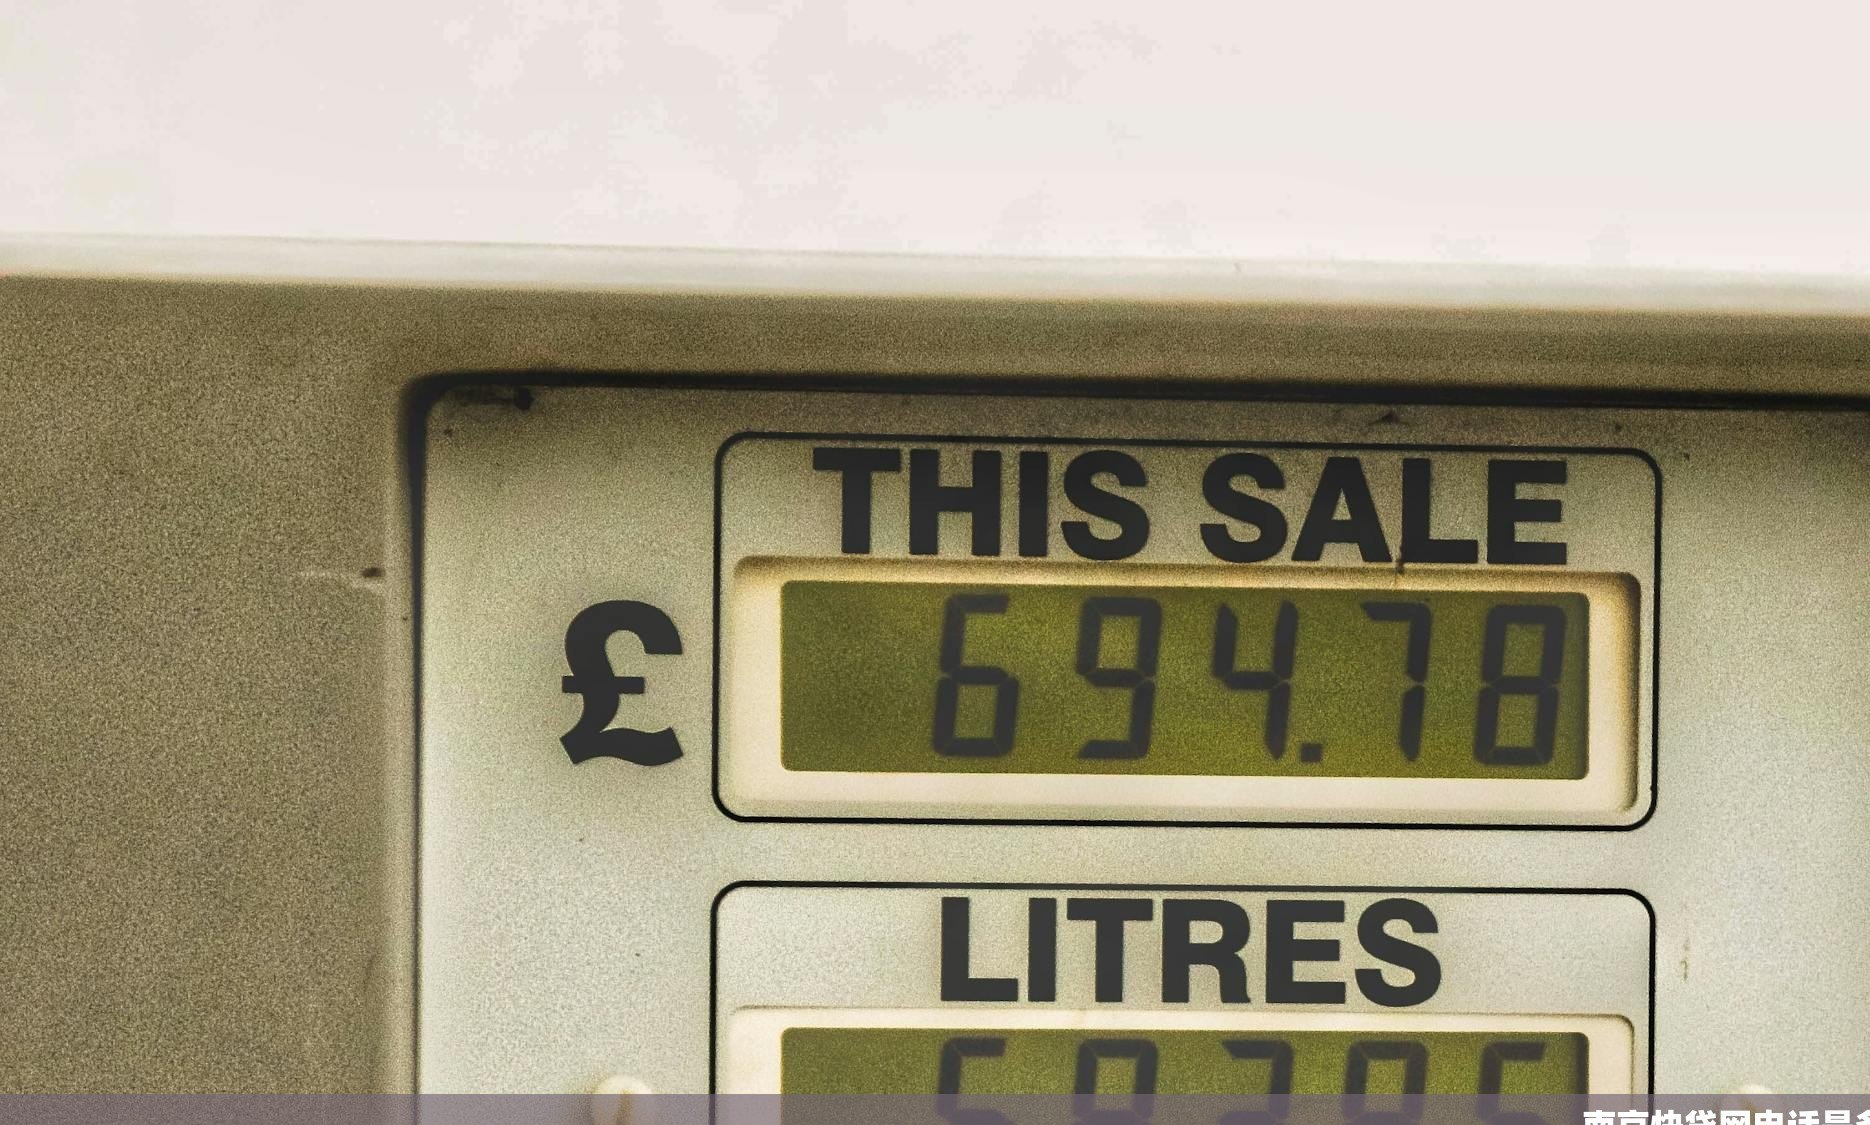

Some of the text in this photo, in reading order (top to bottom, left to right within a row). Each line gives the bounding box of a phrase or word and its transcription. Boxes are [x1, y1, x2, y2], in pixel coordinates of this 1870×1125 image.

[812, 448, 1569, 565] THIS SALE
[930, 594, 1566, 767] 694.78
[938, 895, 1442, 1006] LITRES
